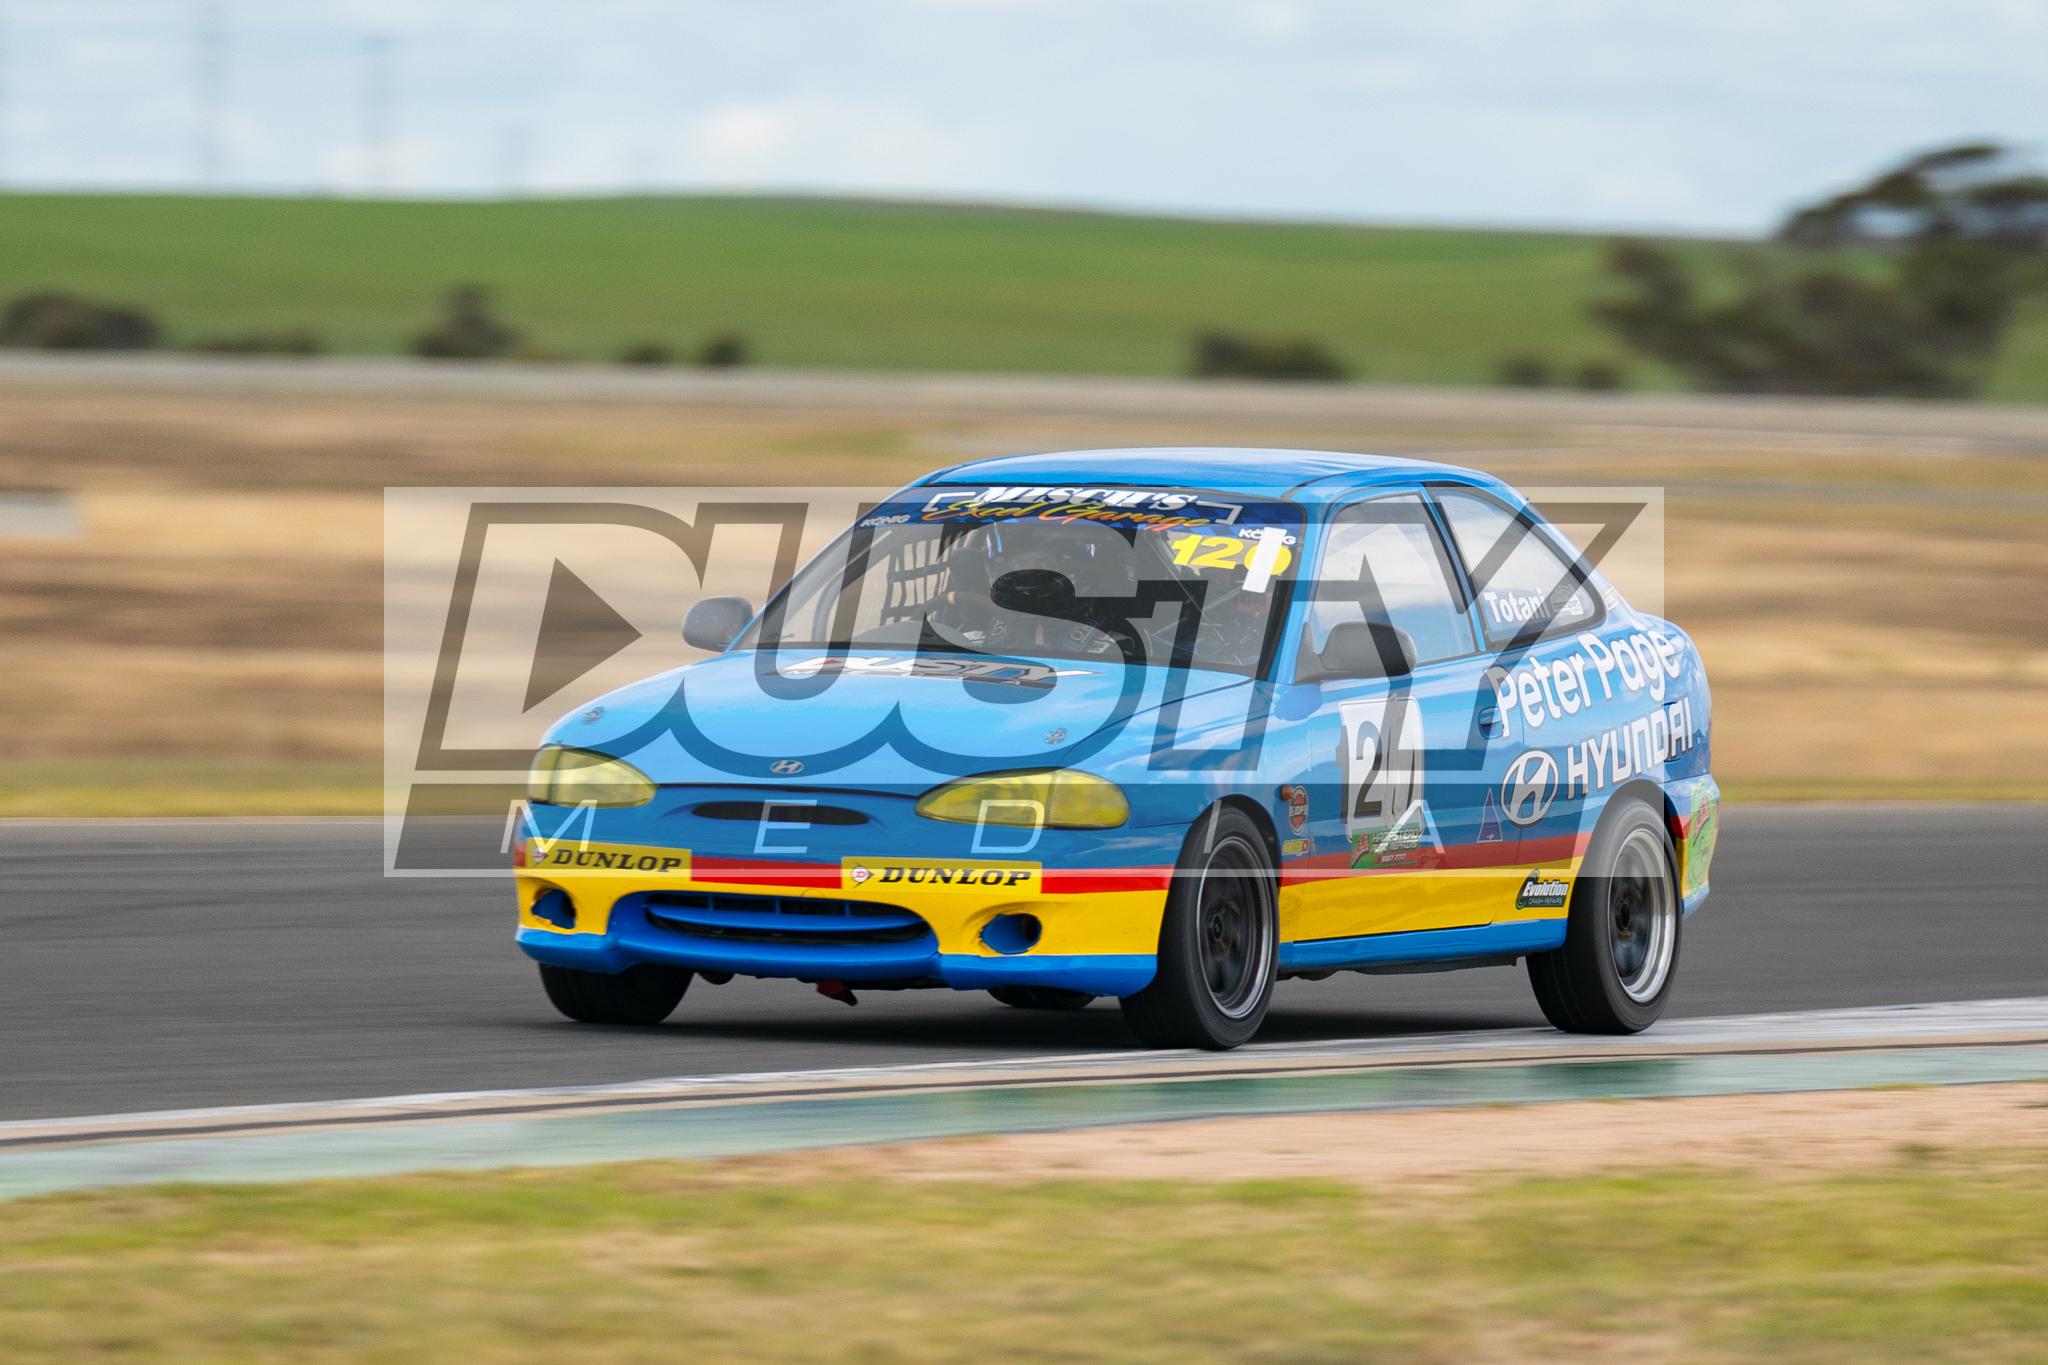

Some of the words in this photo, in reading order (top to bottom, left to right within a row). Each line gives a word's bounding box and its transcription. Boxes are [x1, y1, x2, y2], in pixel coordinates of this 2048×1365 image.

[922, 498, 1050, 521] Excel
[1039, 500, 1211, 532] Garage
[1238, 528, 1297, 546] KÖG
[1483, 587, 1552, 623] Totani
[1484, 653, 1593, 738] Peter
[1577, 630, 1680, 702] Page
[1567, 696, 1694, 800] HYUNDAI
[552, 849, 683, 873] DUNLOP
[879, 867, 1032, 887] DUNLOP
[1522, 880, 1569, 897] Evolution
